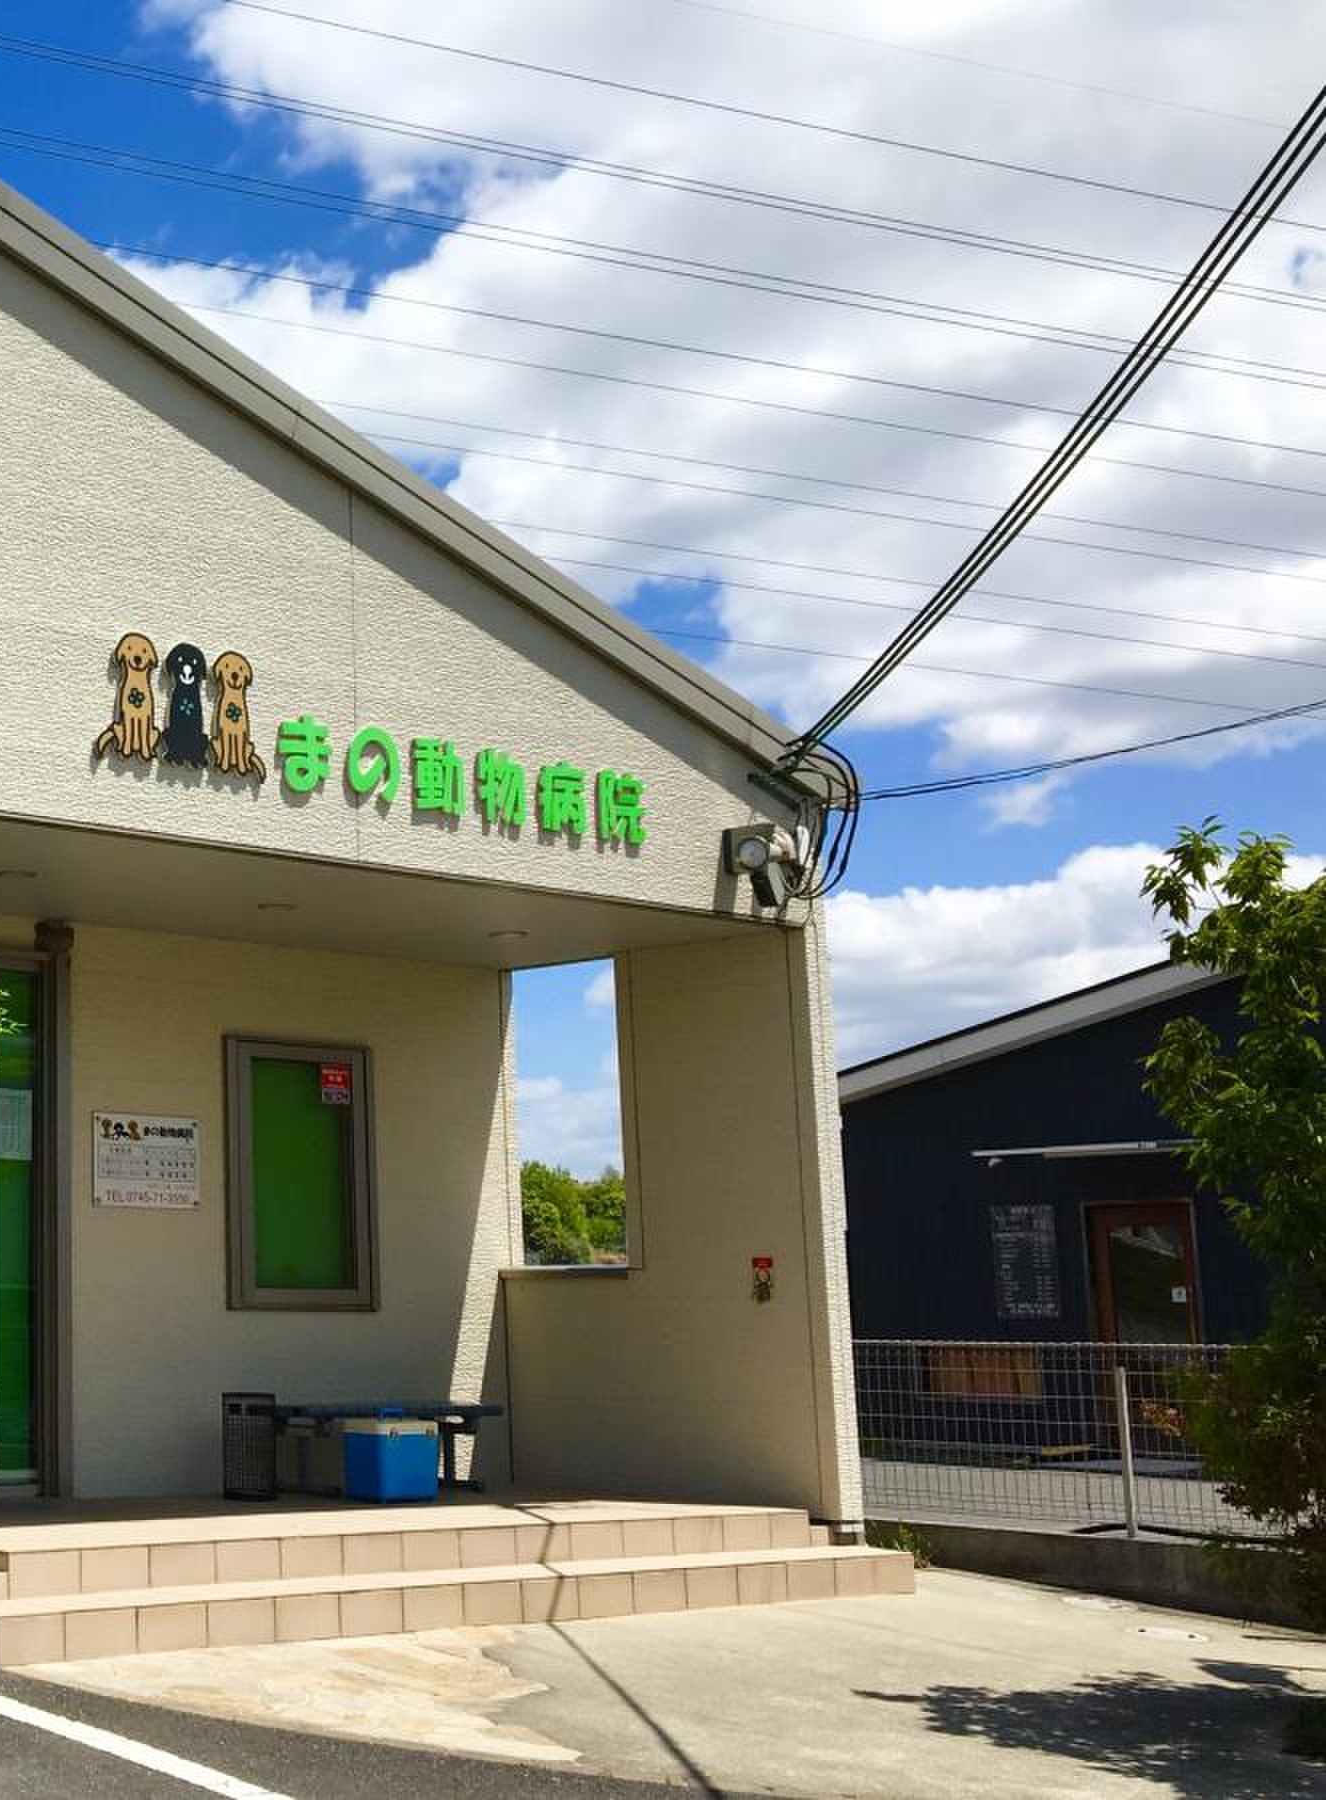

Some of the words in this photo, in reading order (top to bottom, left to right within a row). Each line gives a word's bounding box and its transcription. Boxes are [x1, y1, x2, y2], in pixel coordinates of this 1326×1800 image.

[277, 714, 647, 845] まの動物病院
